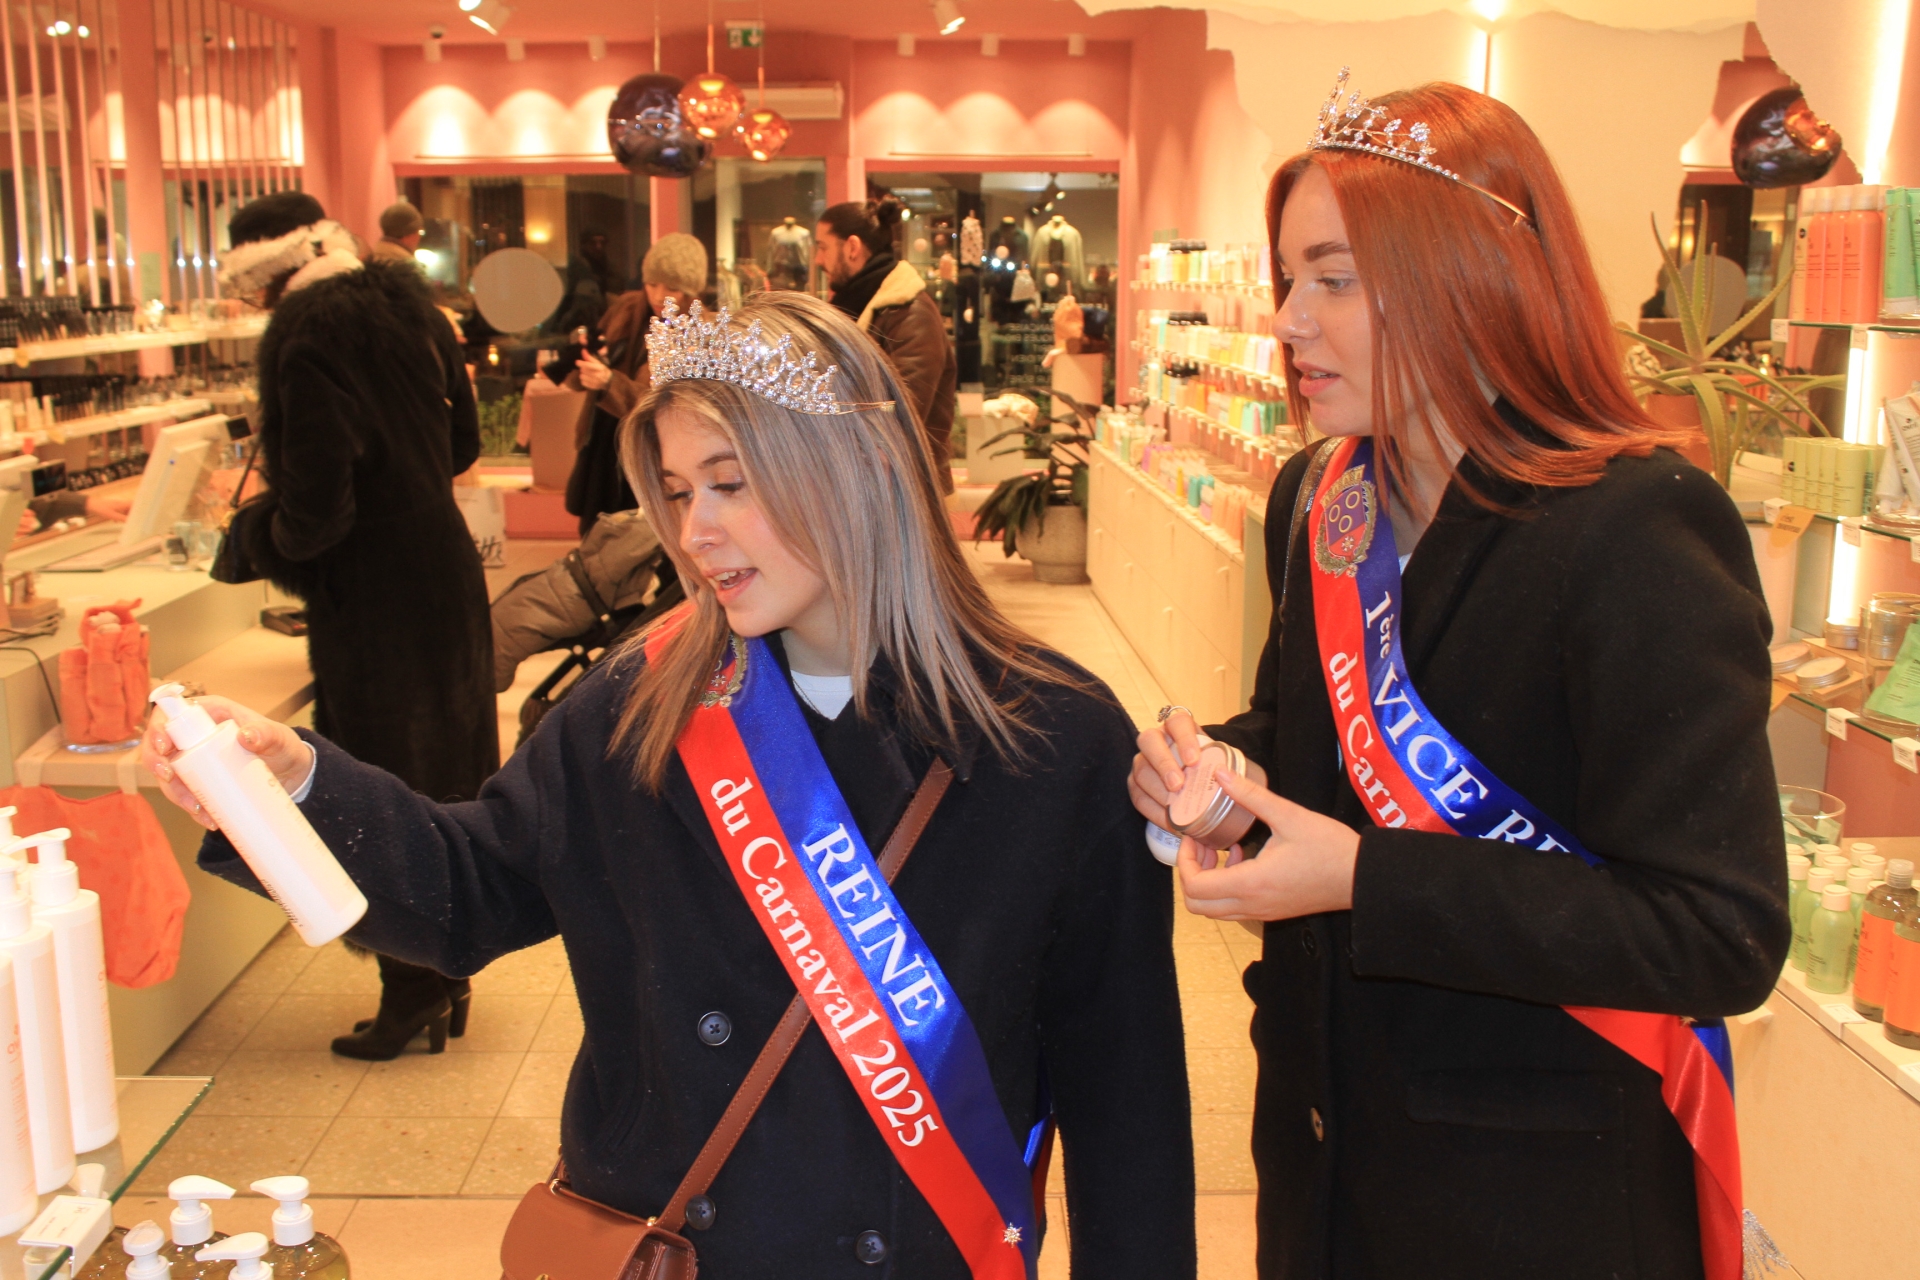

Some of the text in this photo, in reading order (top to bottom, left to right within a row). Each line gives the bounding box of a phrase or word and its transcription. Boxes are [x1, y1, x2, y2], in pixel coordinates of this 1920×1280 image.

[1365, 590, 1394, 659] 1ère
[1329, 651, 1415, 830] du Carn
[1373, 663, 1488, 820] VICE
[710, 777, 939, 1148] du Carnaval 2025
[801, 823, 948, 1028] REINE
